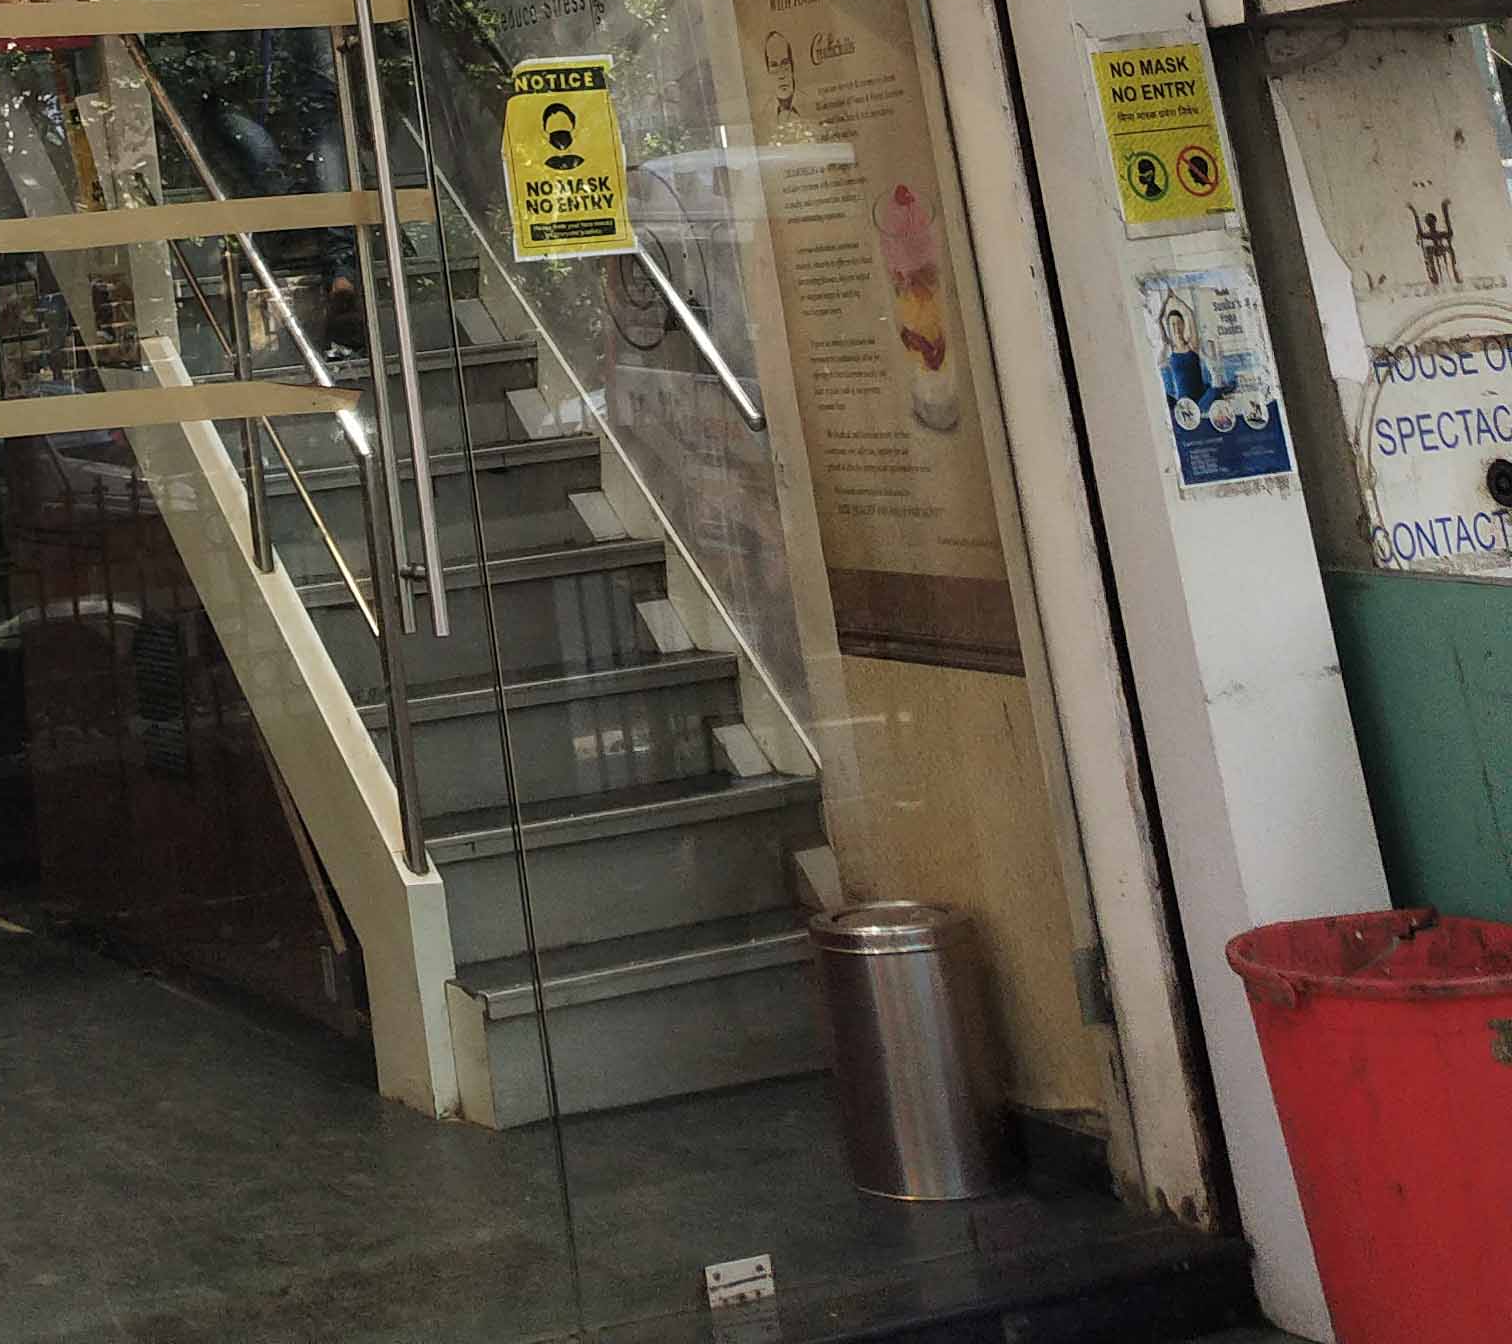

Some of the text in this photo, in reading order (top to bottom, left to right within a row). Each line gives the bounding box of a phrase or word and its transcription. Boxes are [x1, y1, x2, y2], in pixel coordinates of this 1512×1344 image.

[1110, 56, 1190, 79] NO MASK
[515, 72, 595, 92] NOTICE
[1112, 79, 1198, 104] NO ENTRY
[526, 176, 612, 197] NO MASK
[526, 193, 615, 214] NO ENTRY
[1373, 335, 1512, 385] HOUSE O
[1373, 511, 1512, 564] CONTACT
